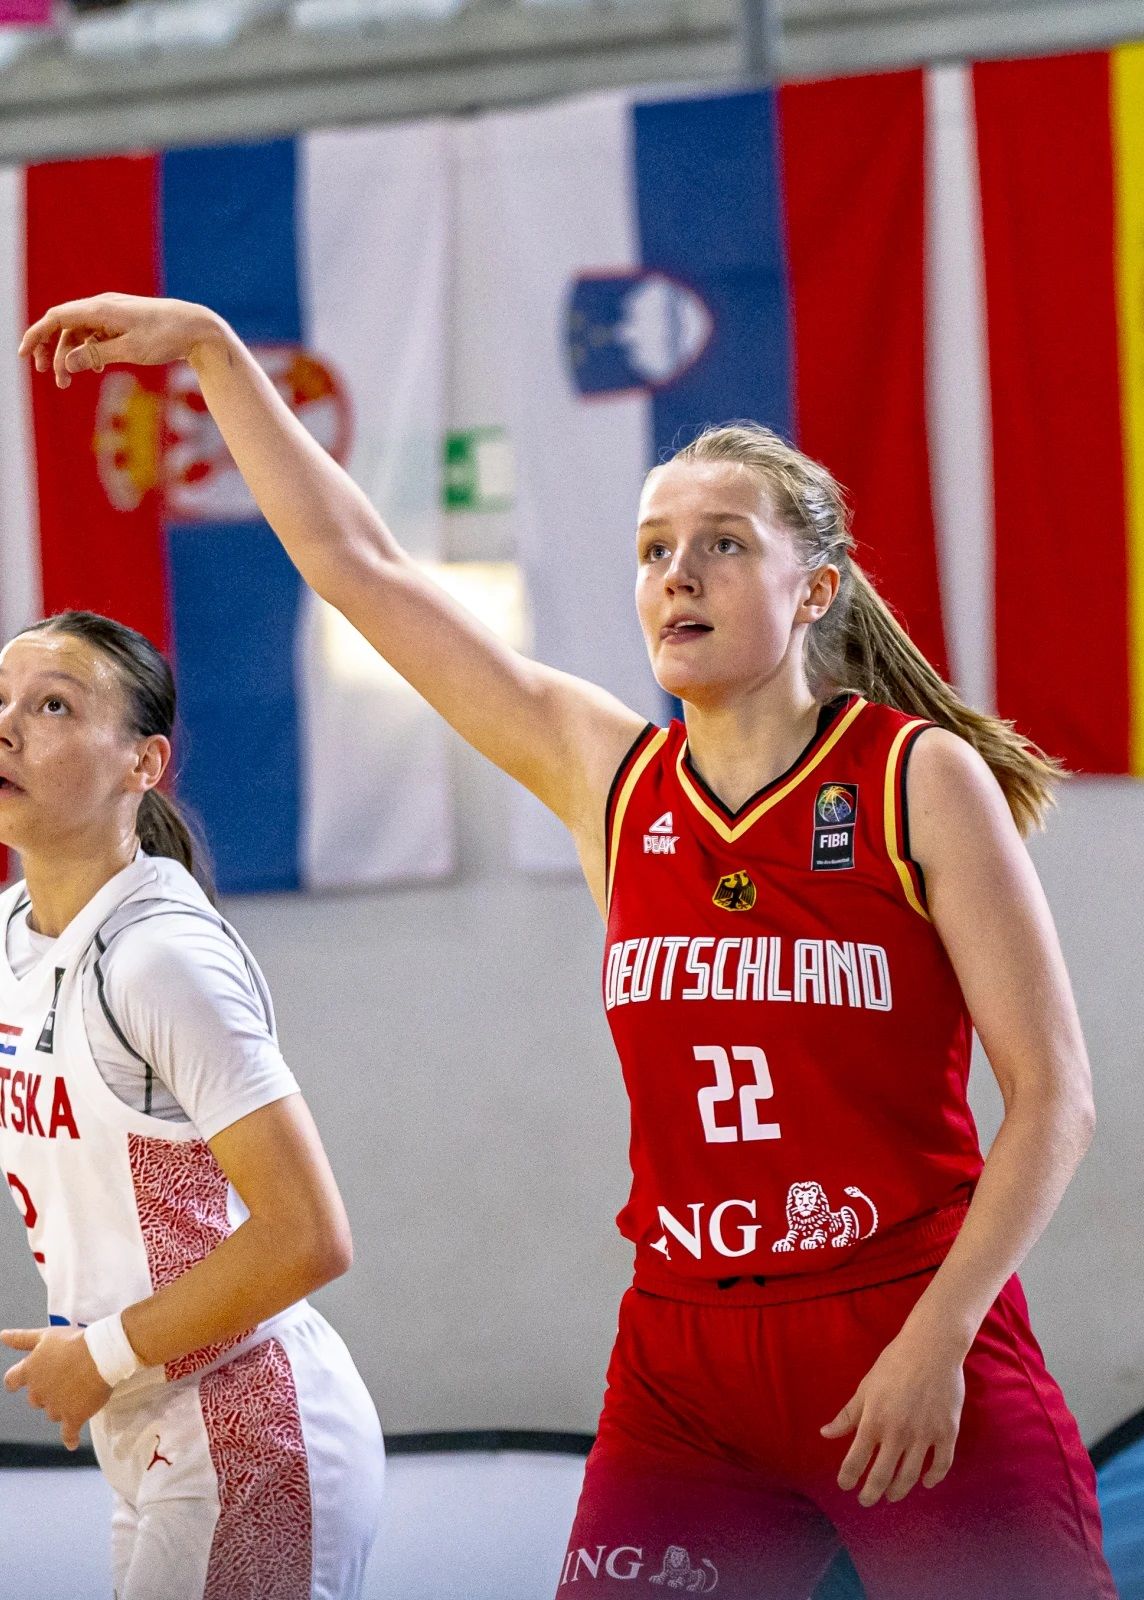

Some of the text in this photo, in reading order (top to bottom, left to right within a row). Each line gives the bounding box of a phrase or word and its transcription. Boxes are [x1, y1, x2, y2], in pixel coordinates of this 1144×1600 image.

[643, 834, 680, 854] PEAK
[819, 832, 849, 849] FIBA
[605, 936, 893, 1012] DEUTSCHLAND
[692, 1045, 782, 1143] 22
[560, 1545, 645, 1586] ING
